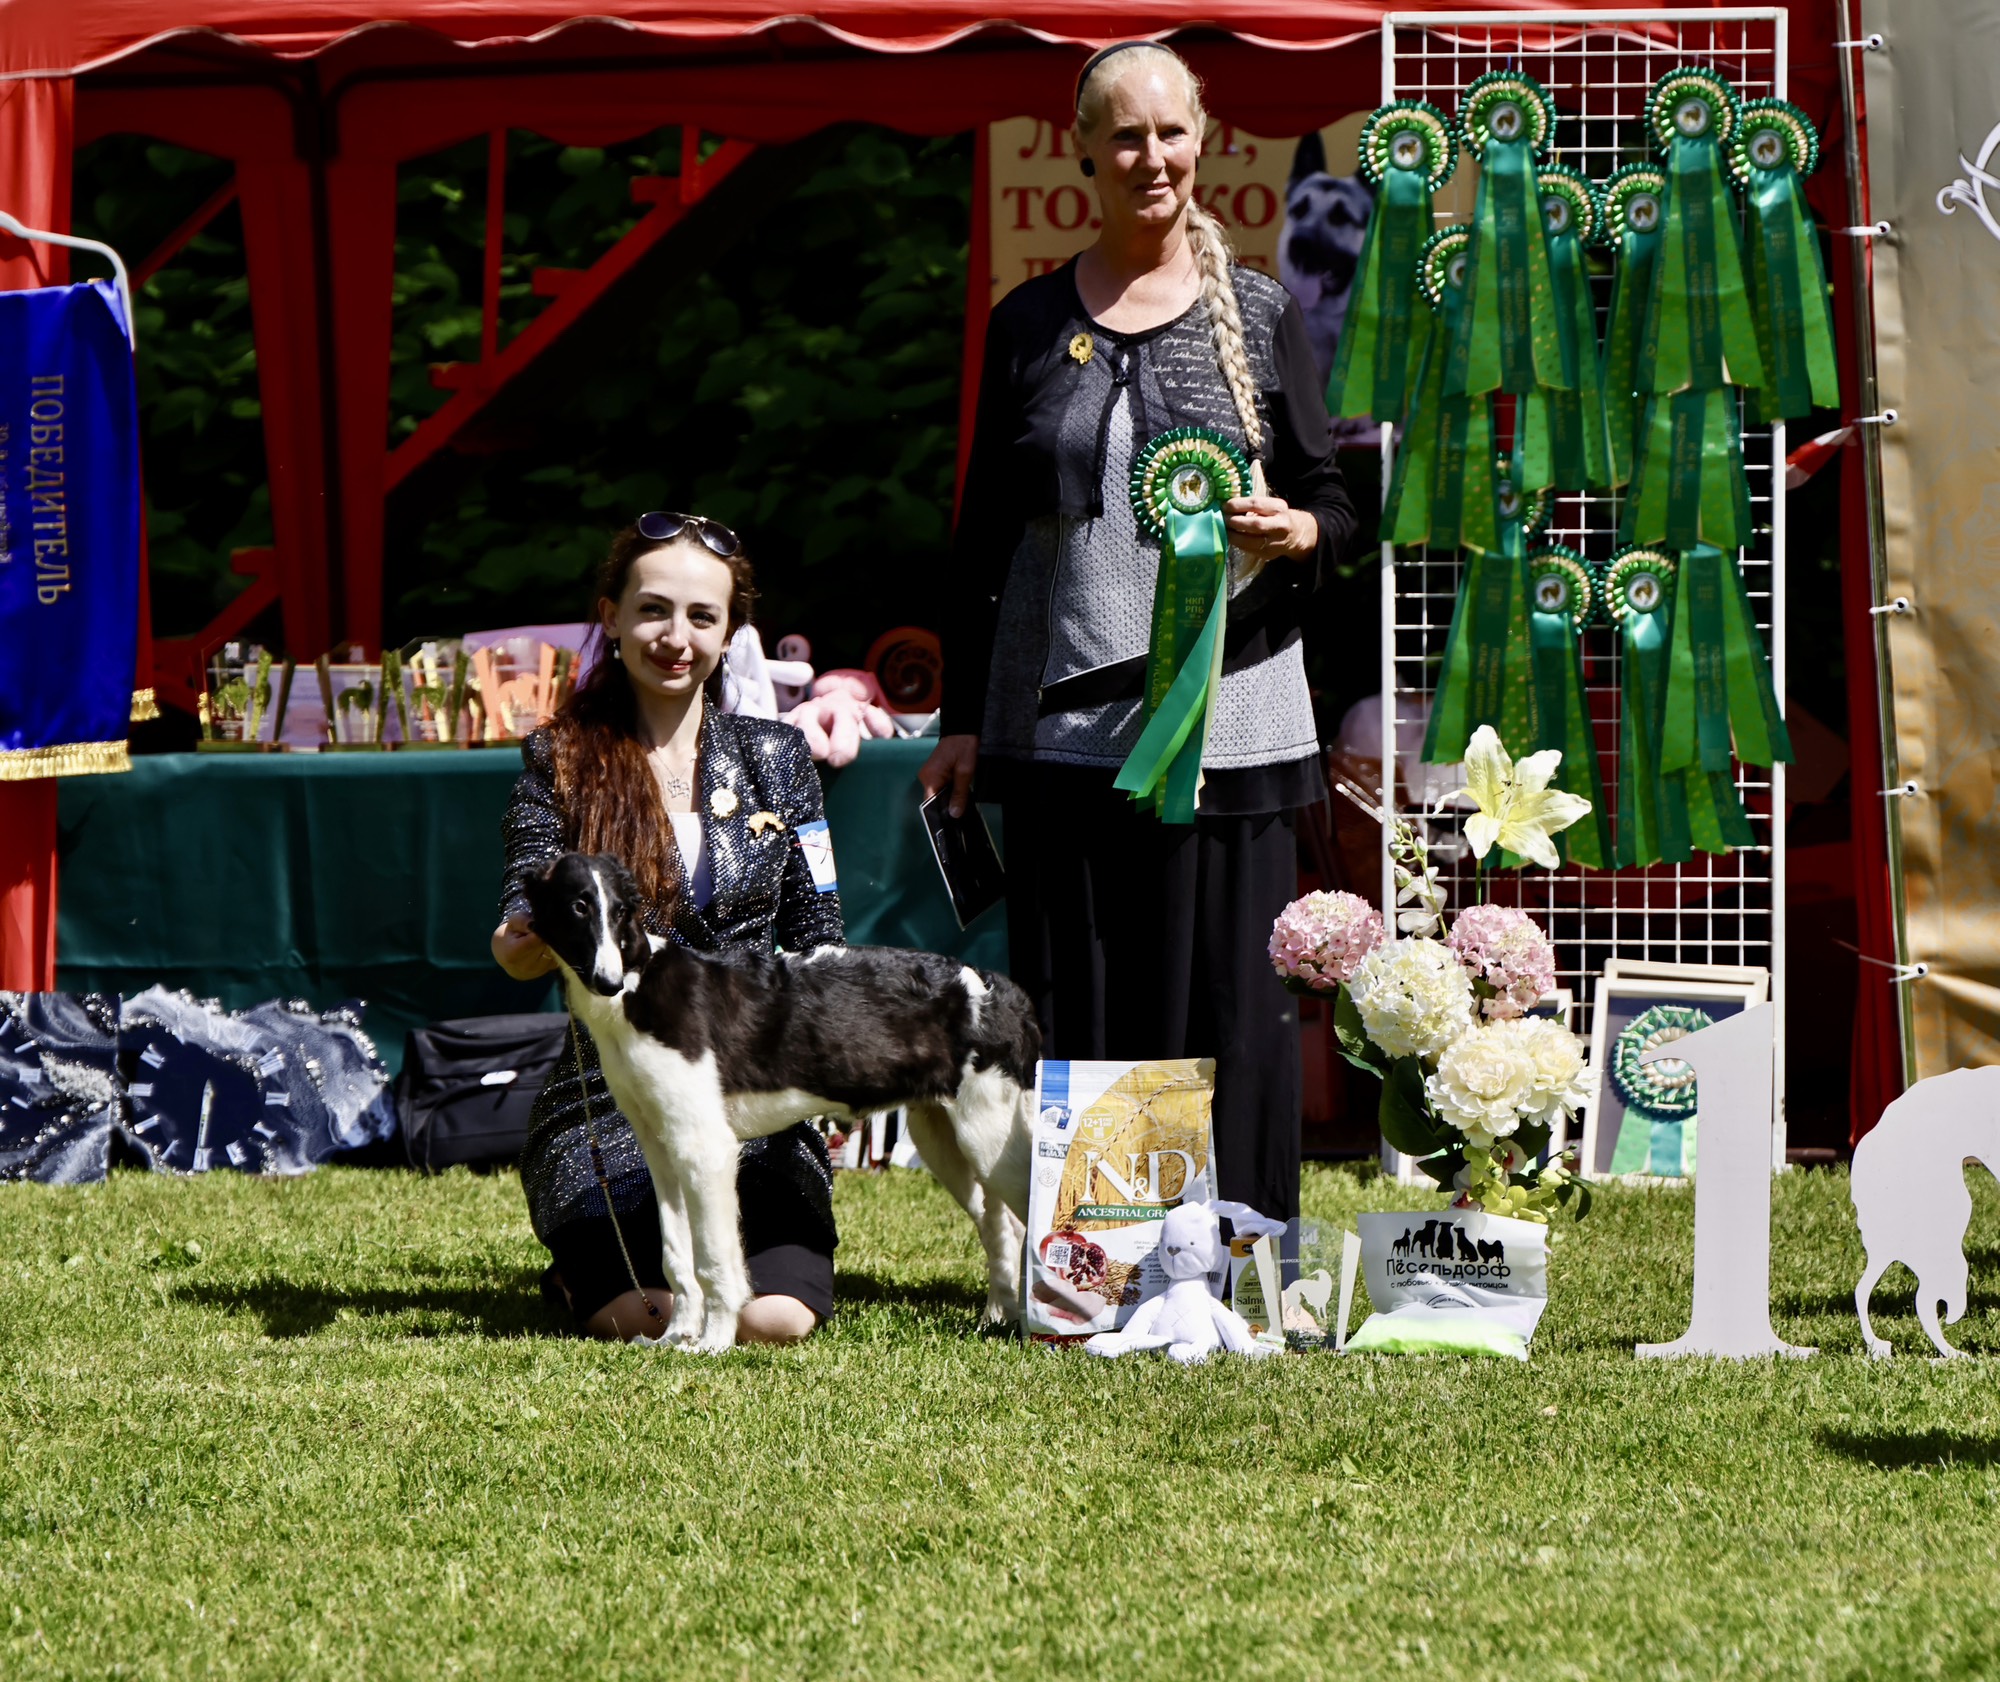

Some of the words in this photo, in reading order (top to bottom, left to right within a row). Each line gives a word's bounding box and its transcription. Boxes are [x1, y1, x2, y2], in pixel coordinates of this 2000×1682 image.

[1002, 183, 1277, 231] ТОКО
[24, 373, 72, 606] ПОБЕДИТЕЛЬ
[1184, 596, 1205, 605] НКП
[1184, 605, 1205, 614] РПБ
[1081, 1149, 1196, 1204] N&D
[1077, 1207, 1145, 1218] ANCESTRAL
[1386, 1258, 1511, 1279] Пёсельдорф
[1236, 1295, 1265, 1306] Salmo
[1248, 1305, 1261, 1315] oil
